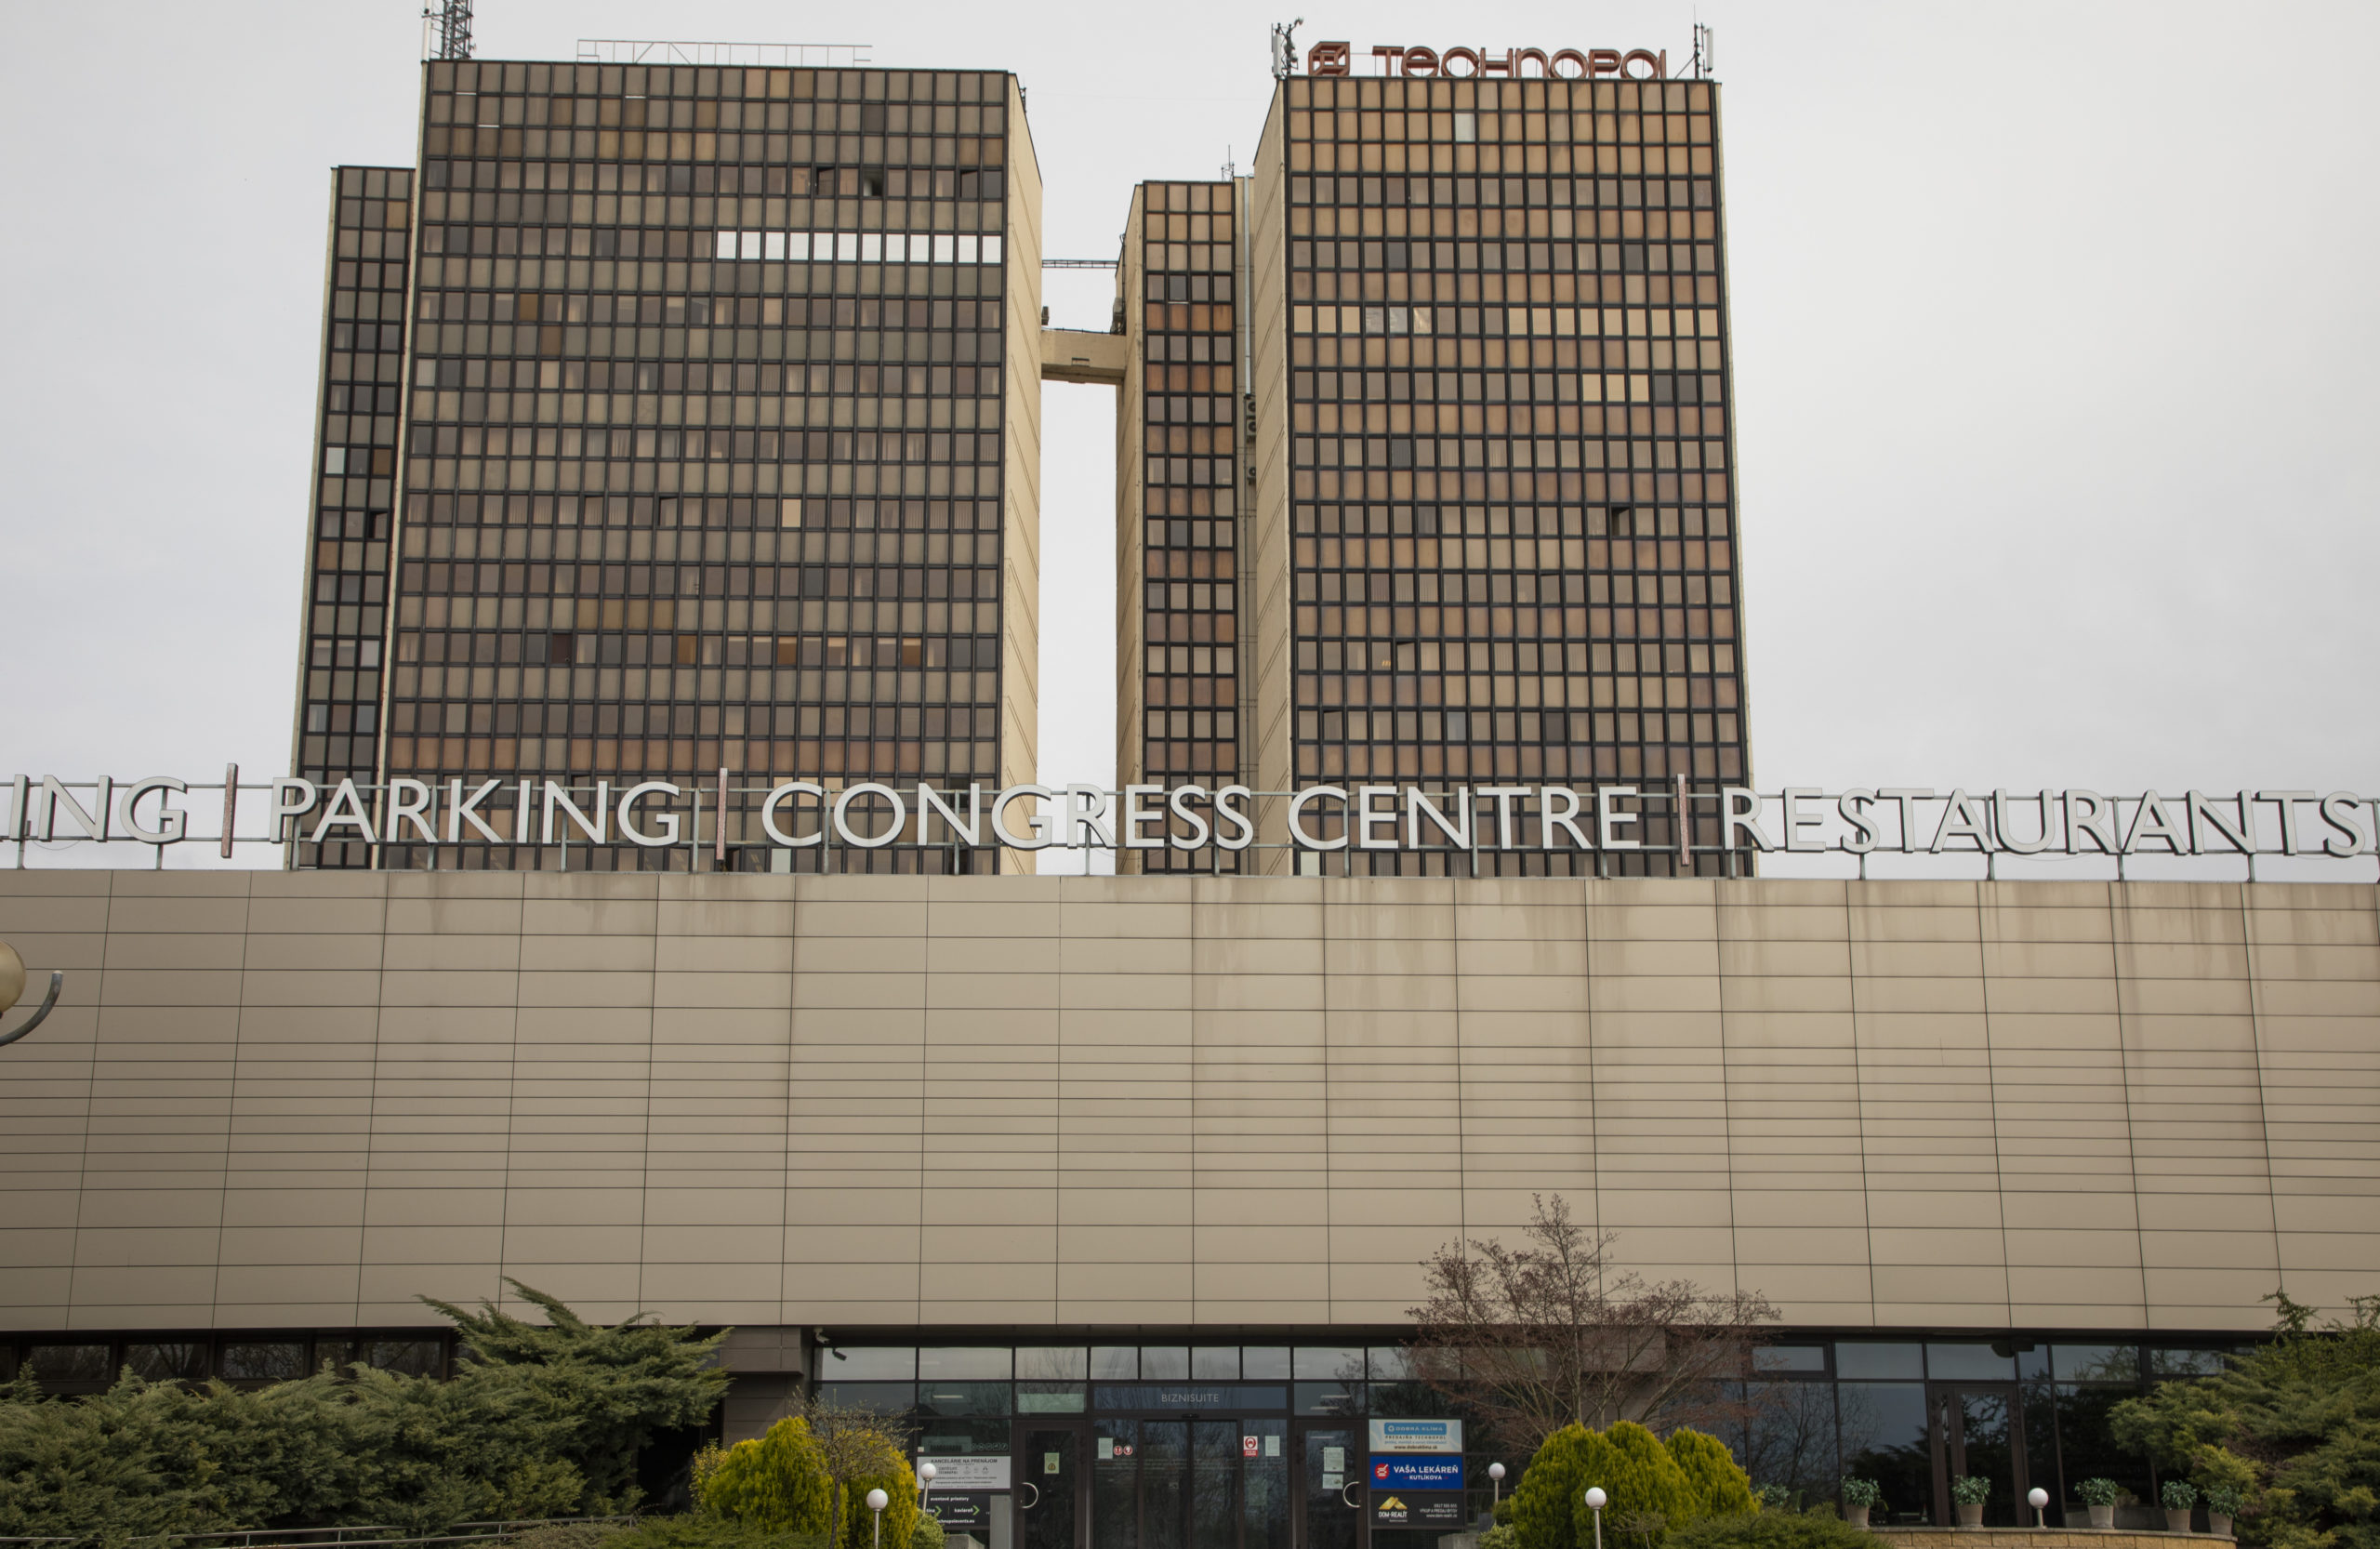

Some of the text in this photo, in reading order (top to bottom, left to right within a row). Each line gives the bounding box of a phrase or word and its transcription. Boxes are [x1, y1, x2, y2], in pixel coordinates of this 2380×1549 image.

[2, 774, 187, 844] ING
[270, 776, 681, 846] PARKING
[761, 781, 1641, 852] CONGRESS CENTRE
[1721, 787, 2360, 857] RESTAURANTS
[1161, 1394, 1219, 1402] BIZNISUITE
[1393, 1464, 1459, 1474] VAŠA LEKÁREŇ
